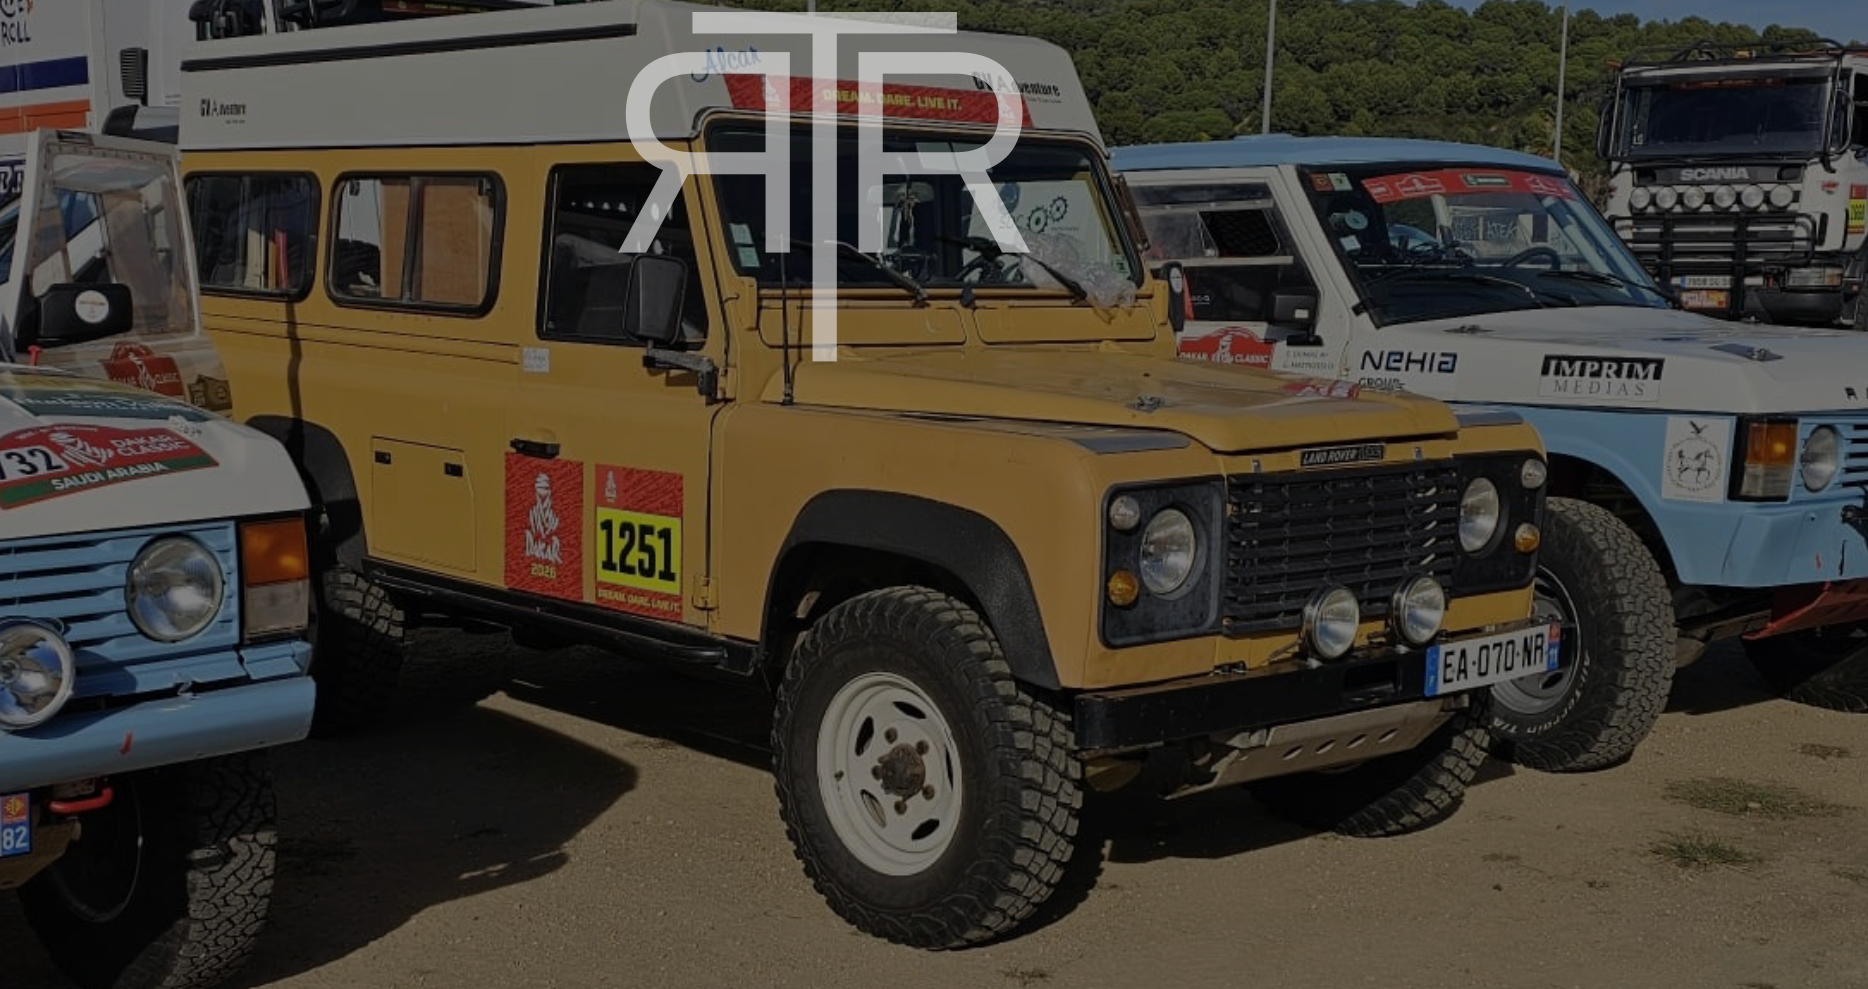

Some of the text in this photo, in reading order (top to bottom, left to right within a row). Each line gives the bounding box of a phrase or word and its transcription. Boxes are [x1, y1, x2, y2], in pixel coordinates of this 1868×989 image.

[877, 94, 915, 107] DARE.
[918, 96, 945, 109] LIVE
[947, 98, 963, 111] IT.
[1680, 167, 1749, 181] SCANIA
[1234, 353, 1271, 364] CLASSIC
[1548, 359, 1657, 380] IMPRIM
[1553, 378, 1646, 397] MEDIAS
[110, 434, 174, 449] DAKAR
[115, 441, 191, 458] CLASSIC
[1303, 450, 1327, 465] LAND
[1328, 446, 1358, 463] ROVER
[51, 460, 168, 491] SAUDI ARABIA
[600, 518, 676, 582] 1251
[531, 562, 557, 580] 2026
[2, 825, 28, 850] 82
